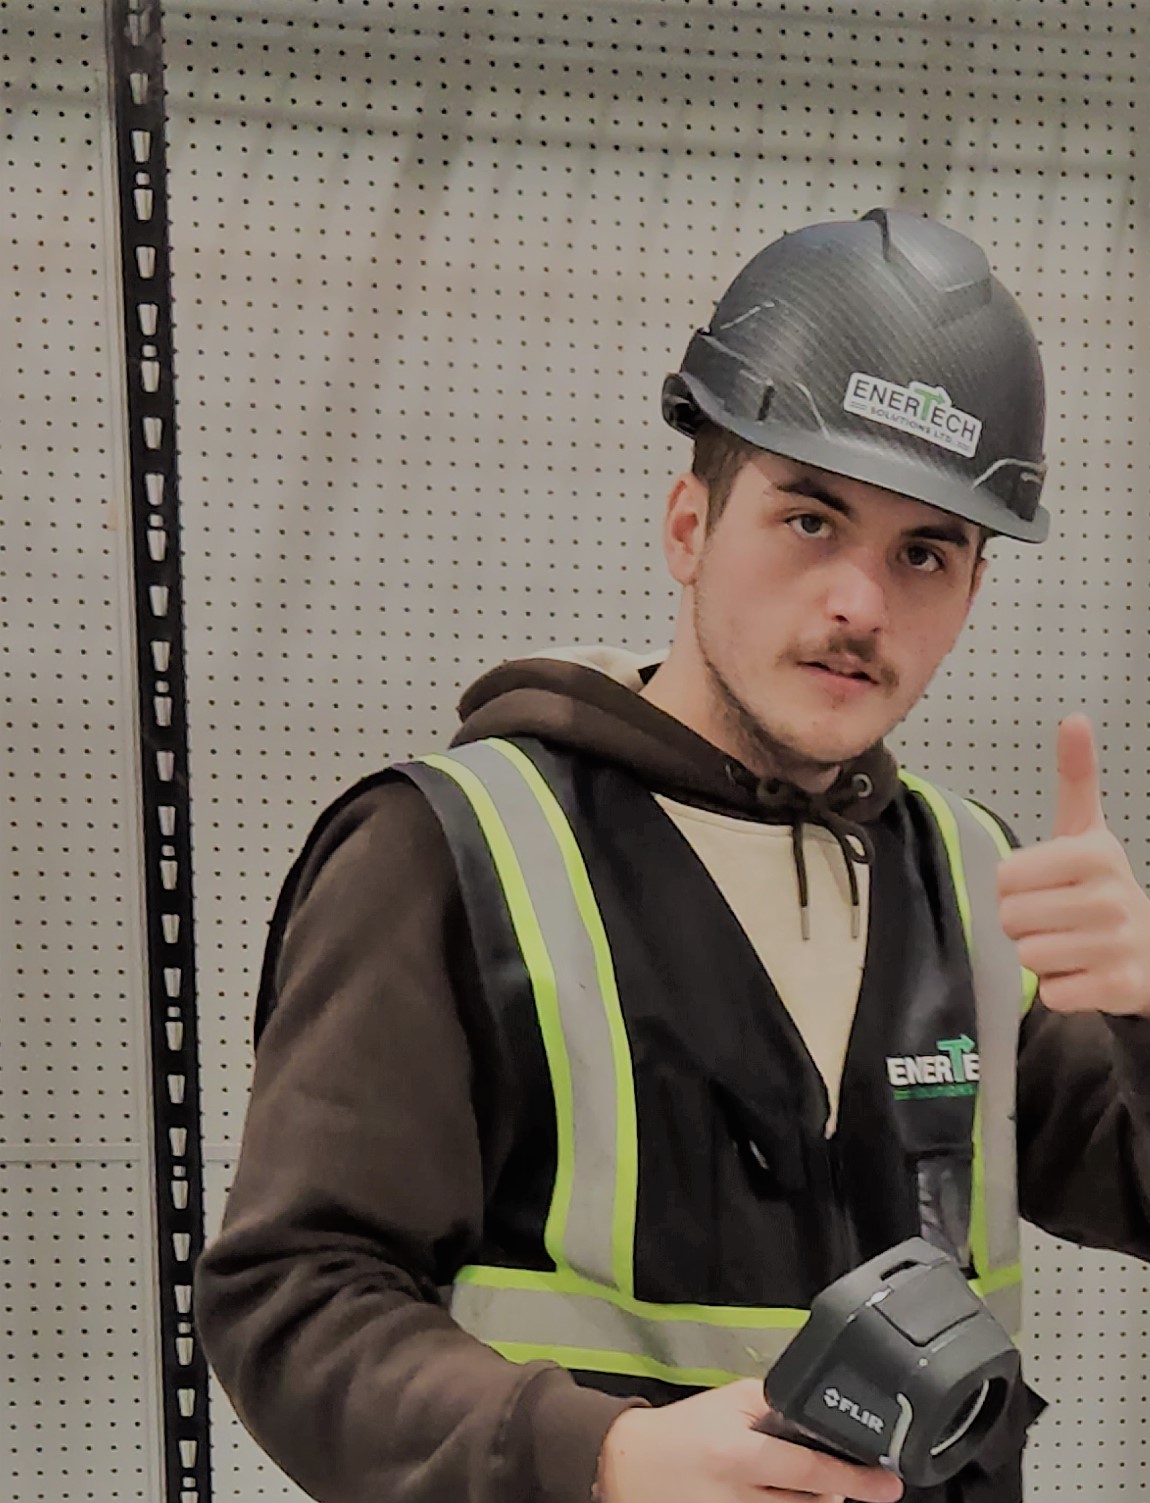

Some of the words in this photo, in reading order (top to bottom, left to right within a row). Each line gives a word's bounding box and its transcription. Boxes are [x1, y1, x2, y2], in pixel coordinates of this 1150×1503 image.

[852, 379, 977, 442] ENERTECH
[870, 405, 931, 434] SOLUTIONS
[838, 1397, 884, 1434] FLIR
